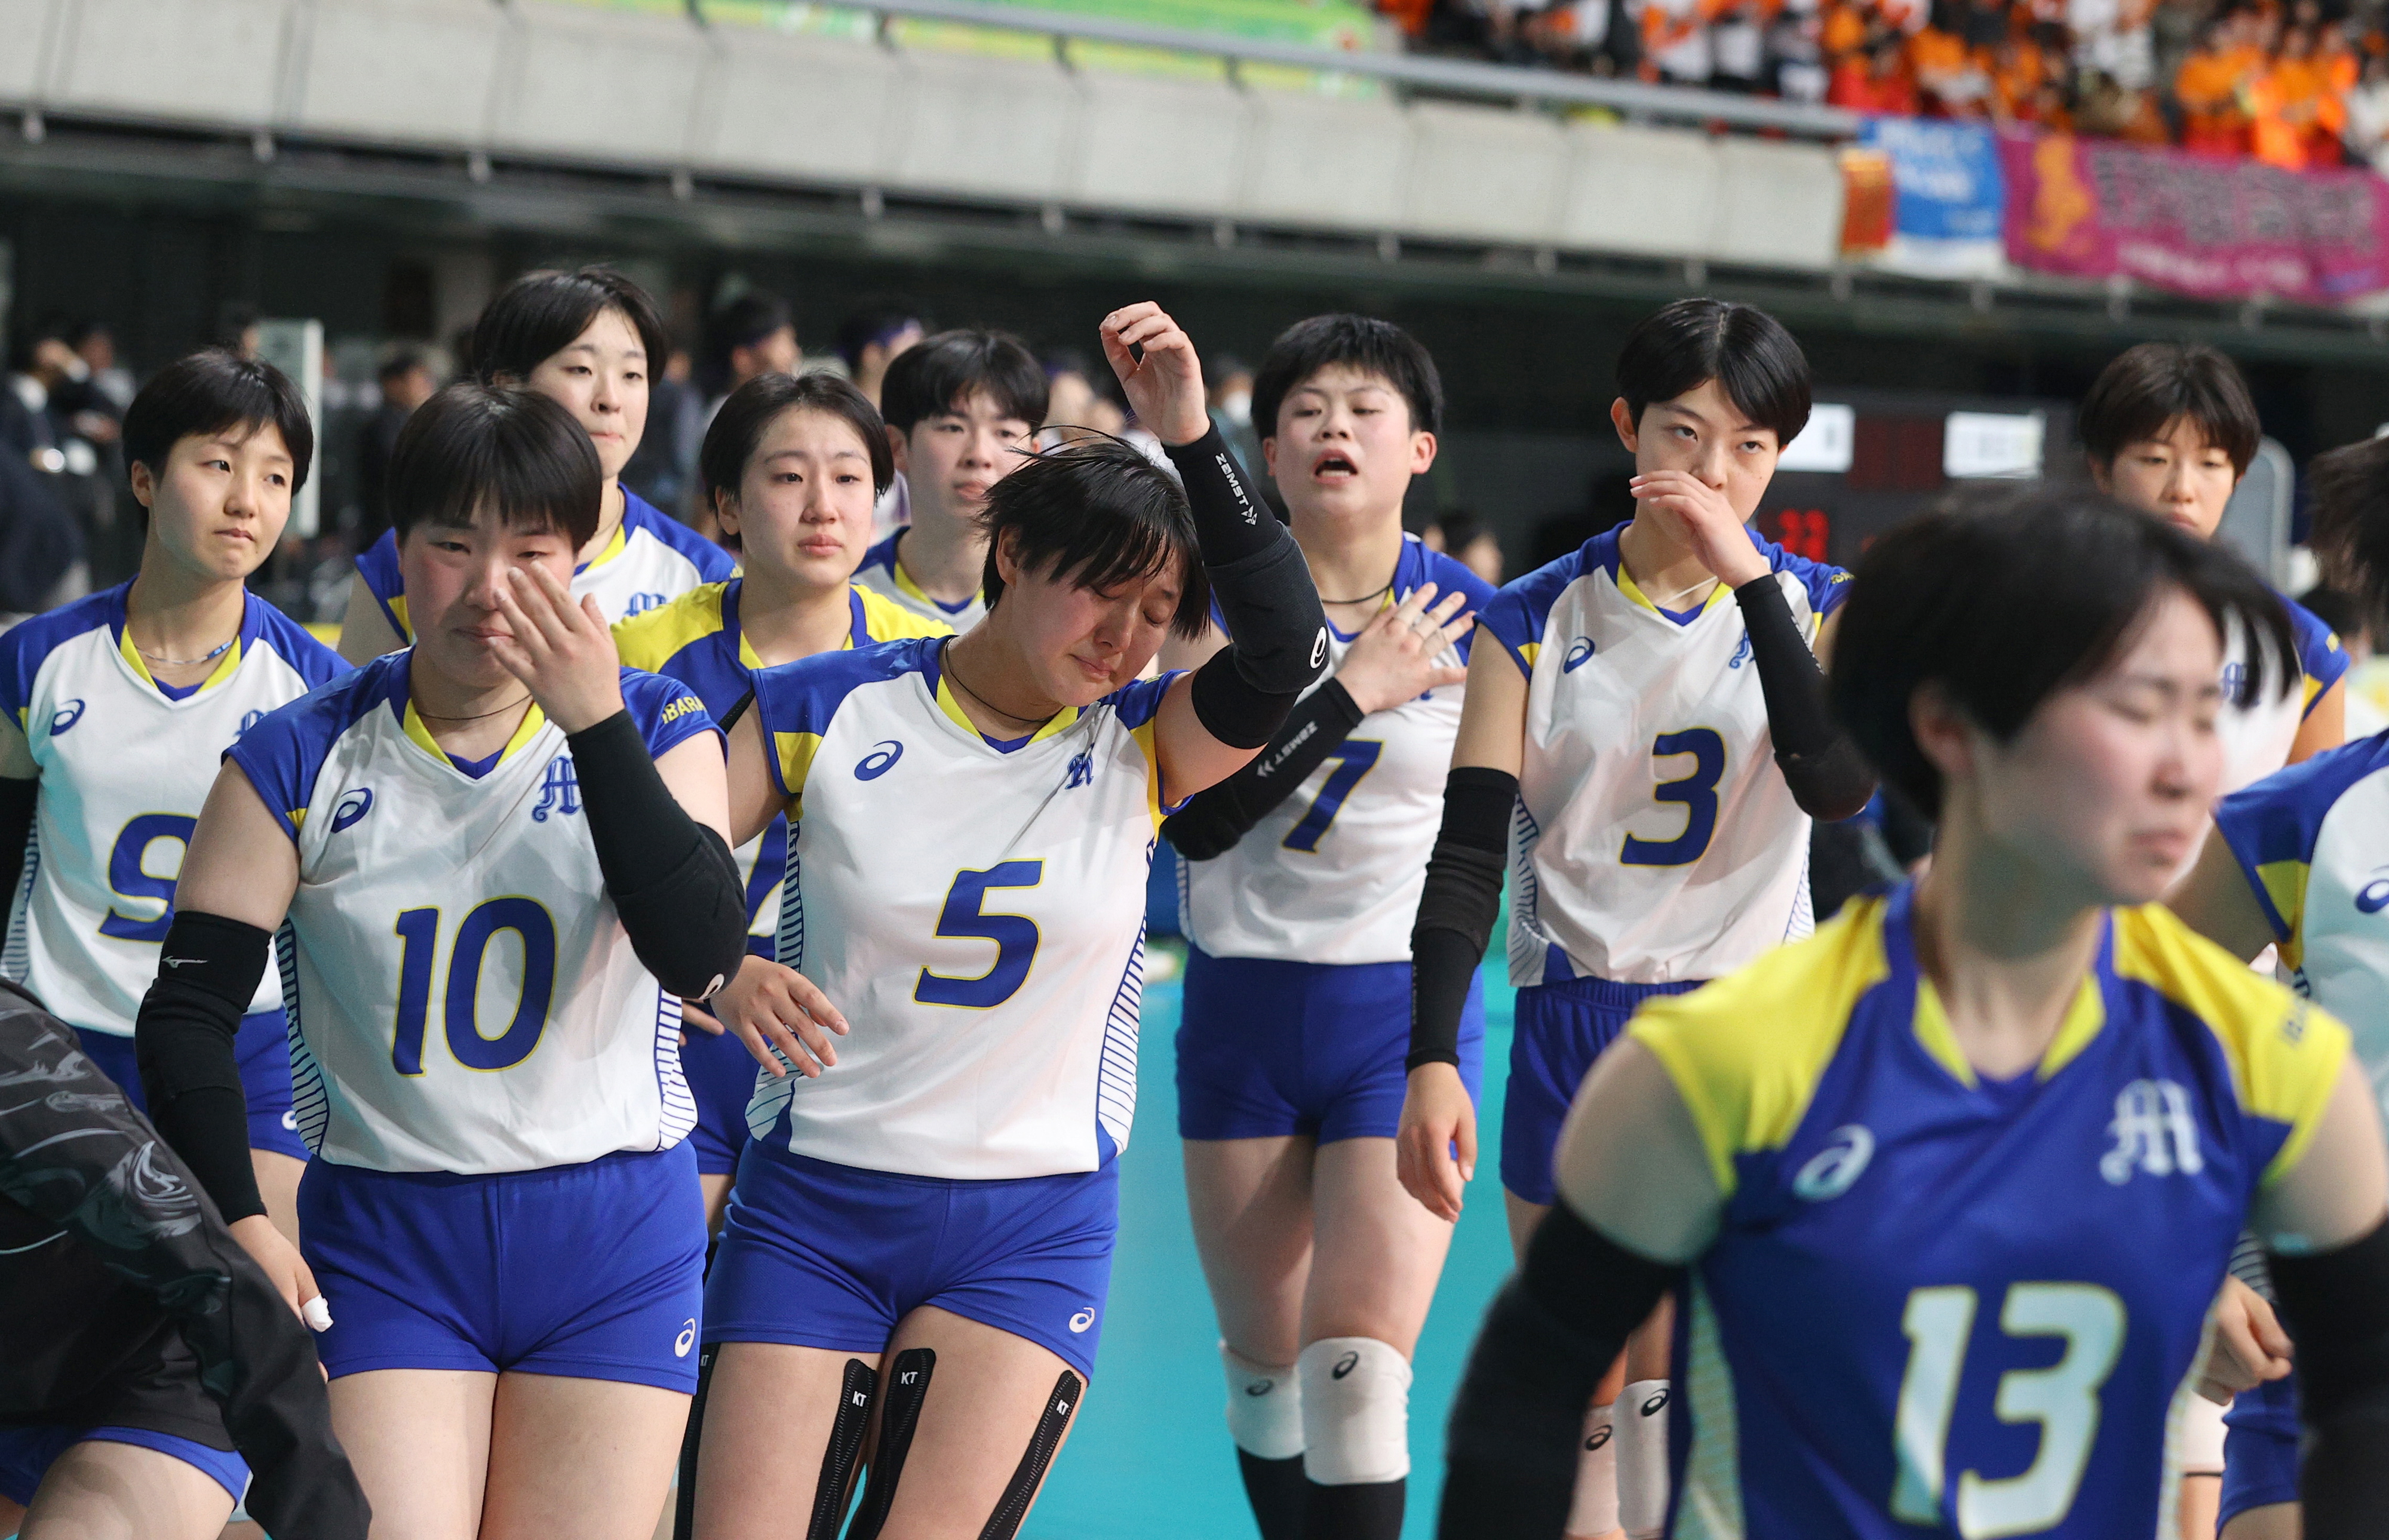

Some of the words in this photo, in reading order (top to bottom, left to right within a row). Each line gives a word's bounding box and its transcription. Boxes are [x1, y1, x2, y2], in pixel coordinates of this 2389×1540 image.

[1281, 735, 1386, 856] 7
[1617, 726, 1728, 869] 3
[97, 810, 200, 945] 9
[911, 857, 1046, 1010] 5
[391, 894, 560, 1078] 10
[852, 1390, 867, 1407] KT
[901, 1371, 919, 1385] KT
[1056, 1399, 1070, 1415] KT
[1887, 1280, 2129, 1540] 13
